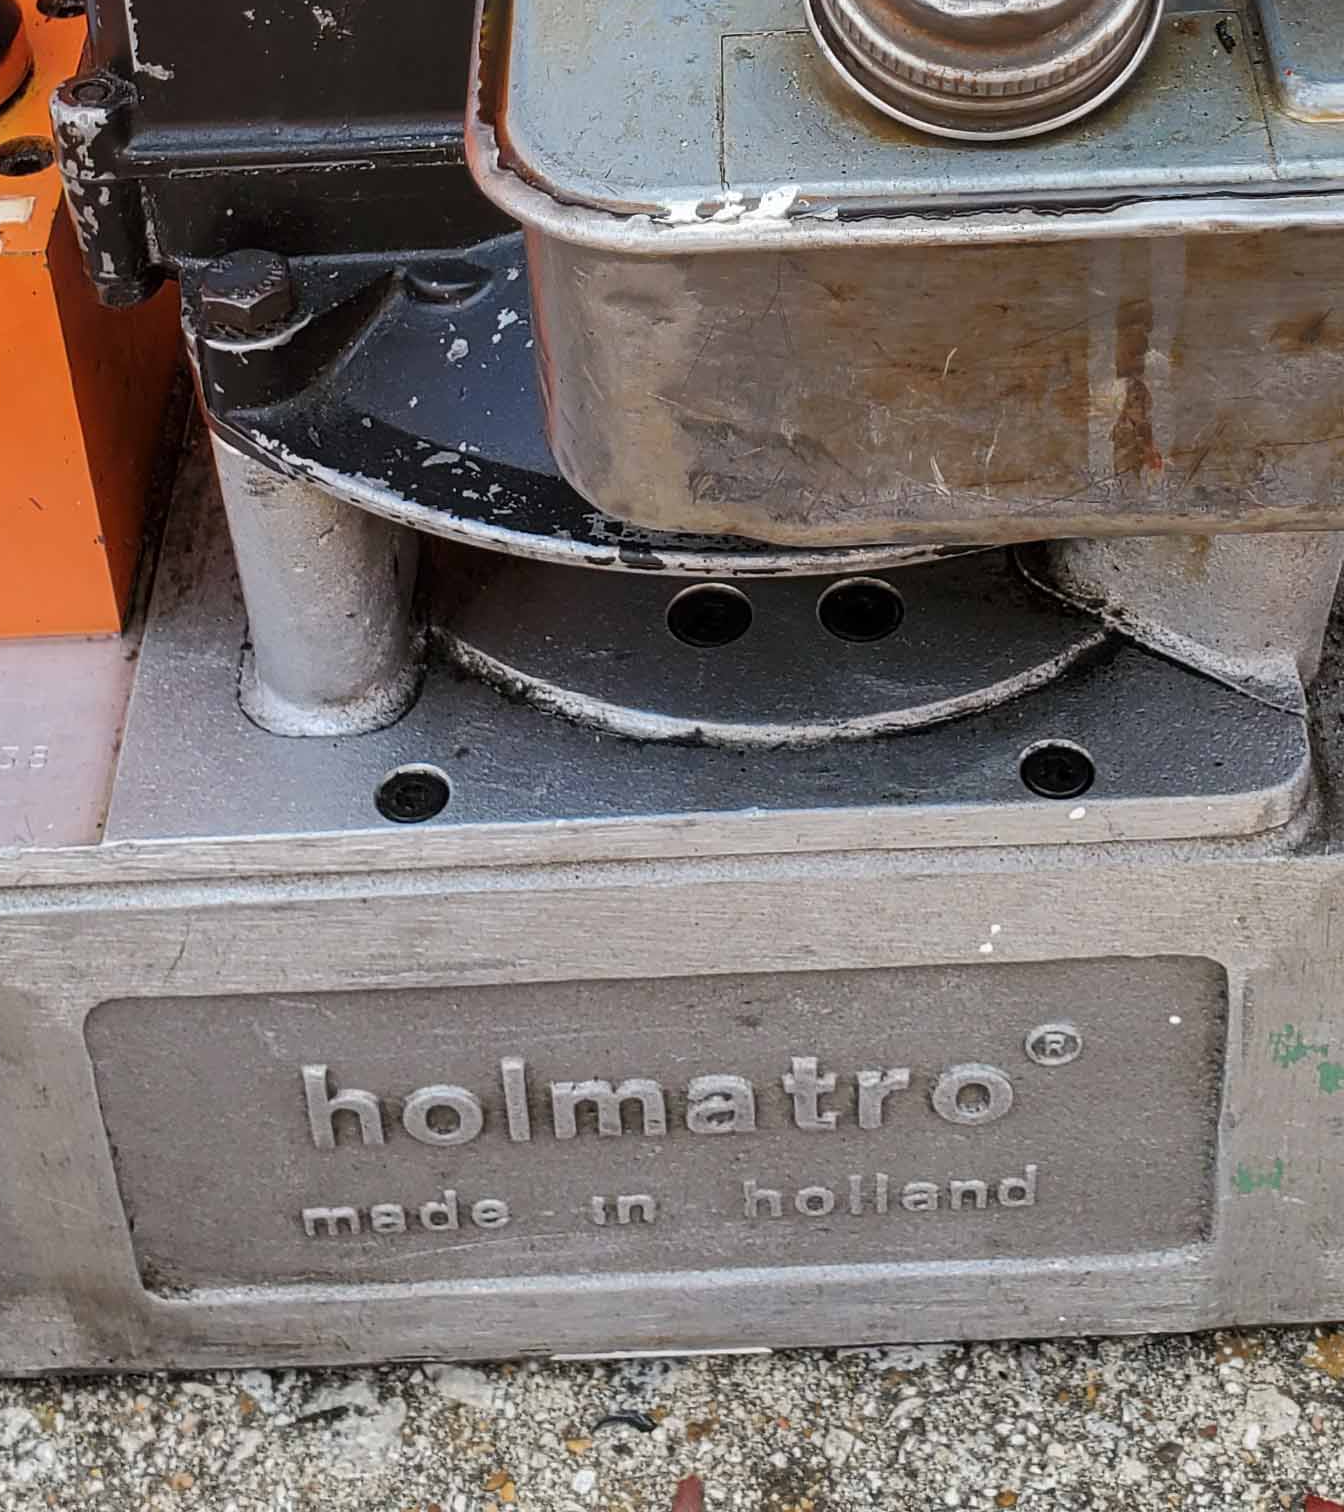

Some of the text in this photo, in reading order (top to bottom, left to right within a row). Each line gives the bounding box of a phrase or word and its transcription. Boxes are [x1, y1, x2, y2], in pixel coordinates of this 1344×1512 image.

[301, 1055, 1014, 1150] holmatro
[302, 1164, 1038, 1237] made in holland
